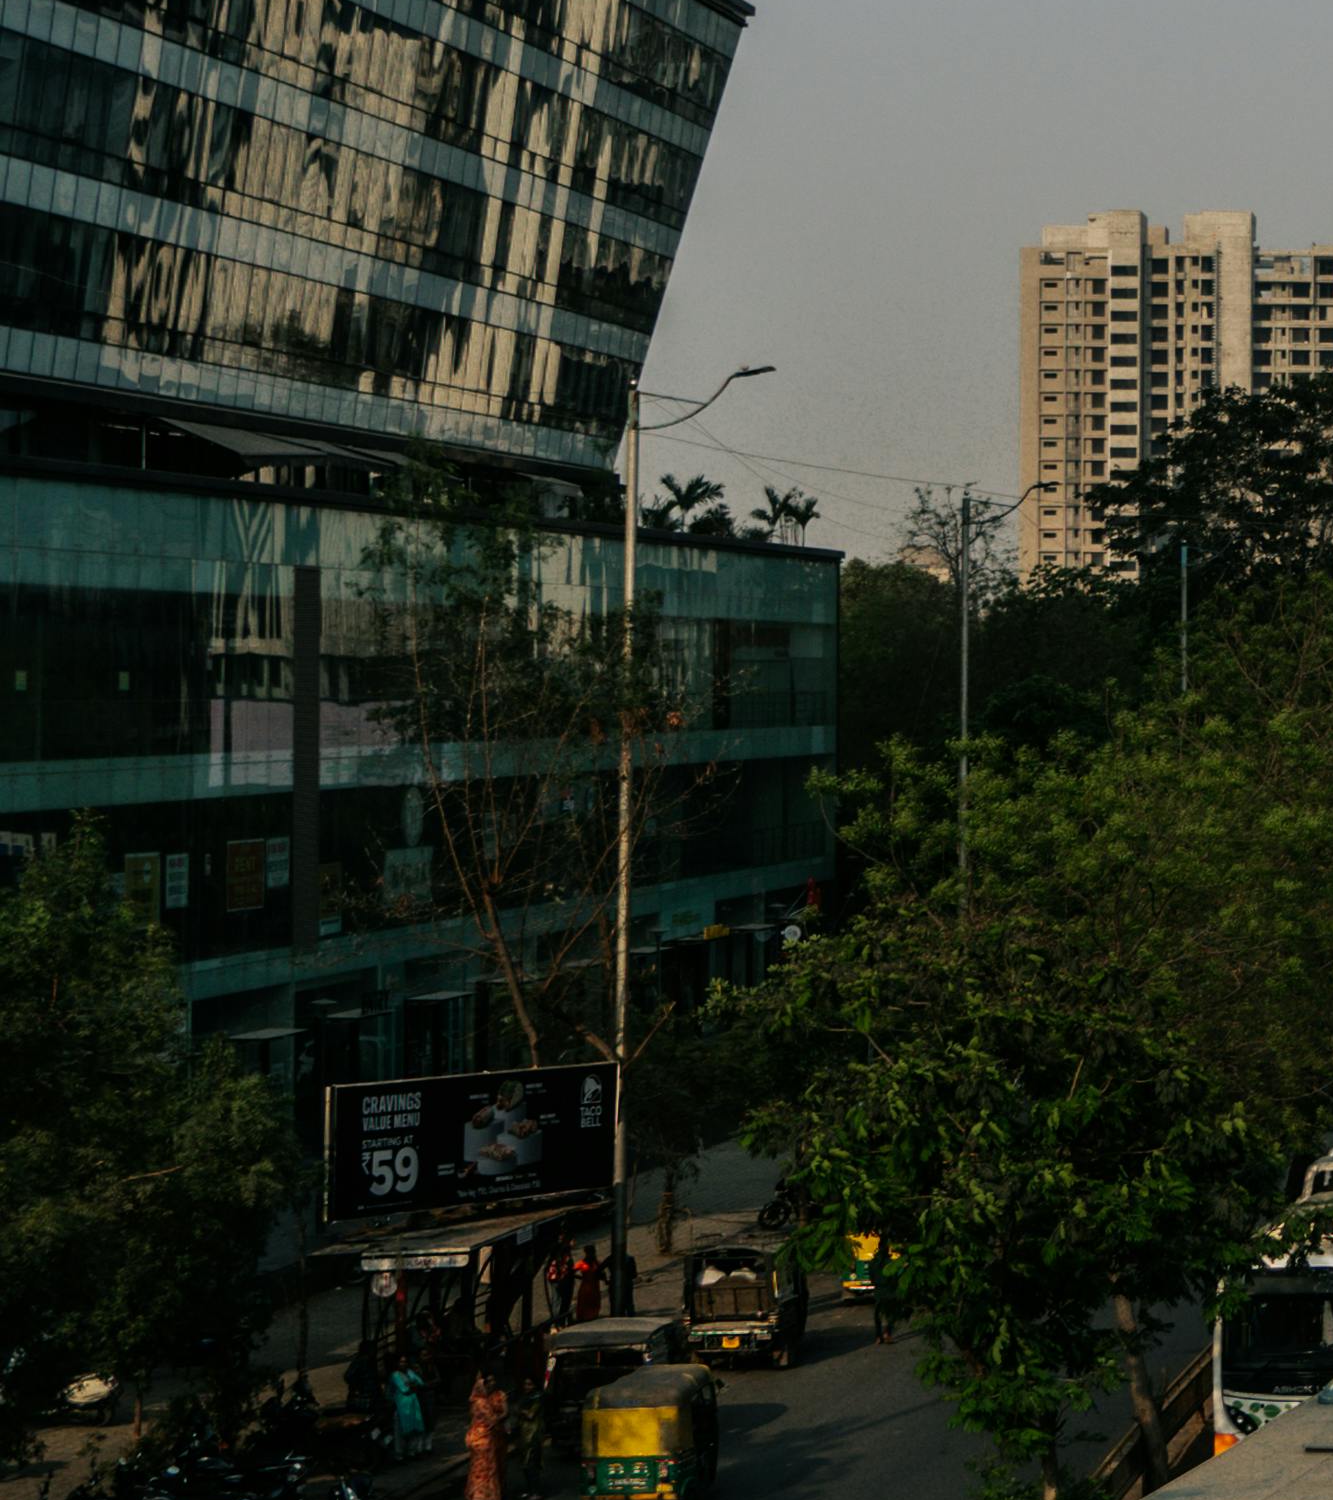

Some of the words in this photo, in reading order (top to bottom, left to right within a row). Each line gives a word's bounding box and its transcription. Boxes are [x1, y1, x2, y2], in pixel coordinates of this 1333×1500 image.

[362, 1091, 422, 1115] CRAVINGS
[580, 1104, 602, 1117] TACO
[362, 1115, 392, 1132] VALUE
[393, 1111, 421, 1129] MENU
[580, 1114, 602, 1128] BELL
[362, 1137, 402, 1149] STARTING
[403, 1134, 415, 1145] AT
